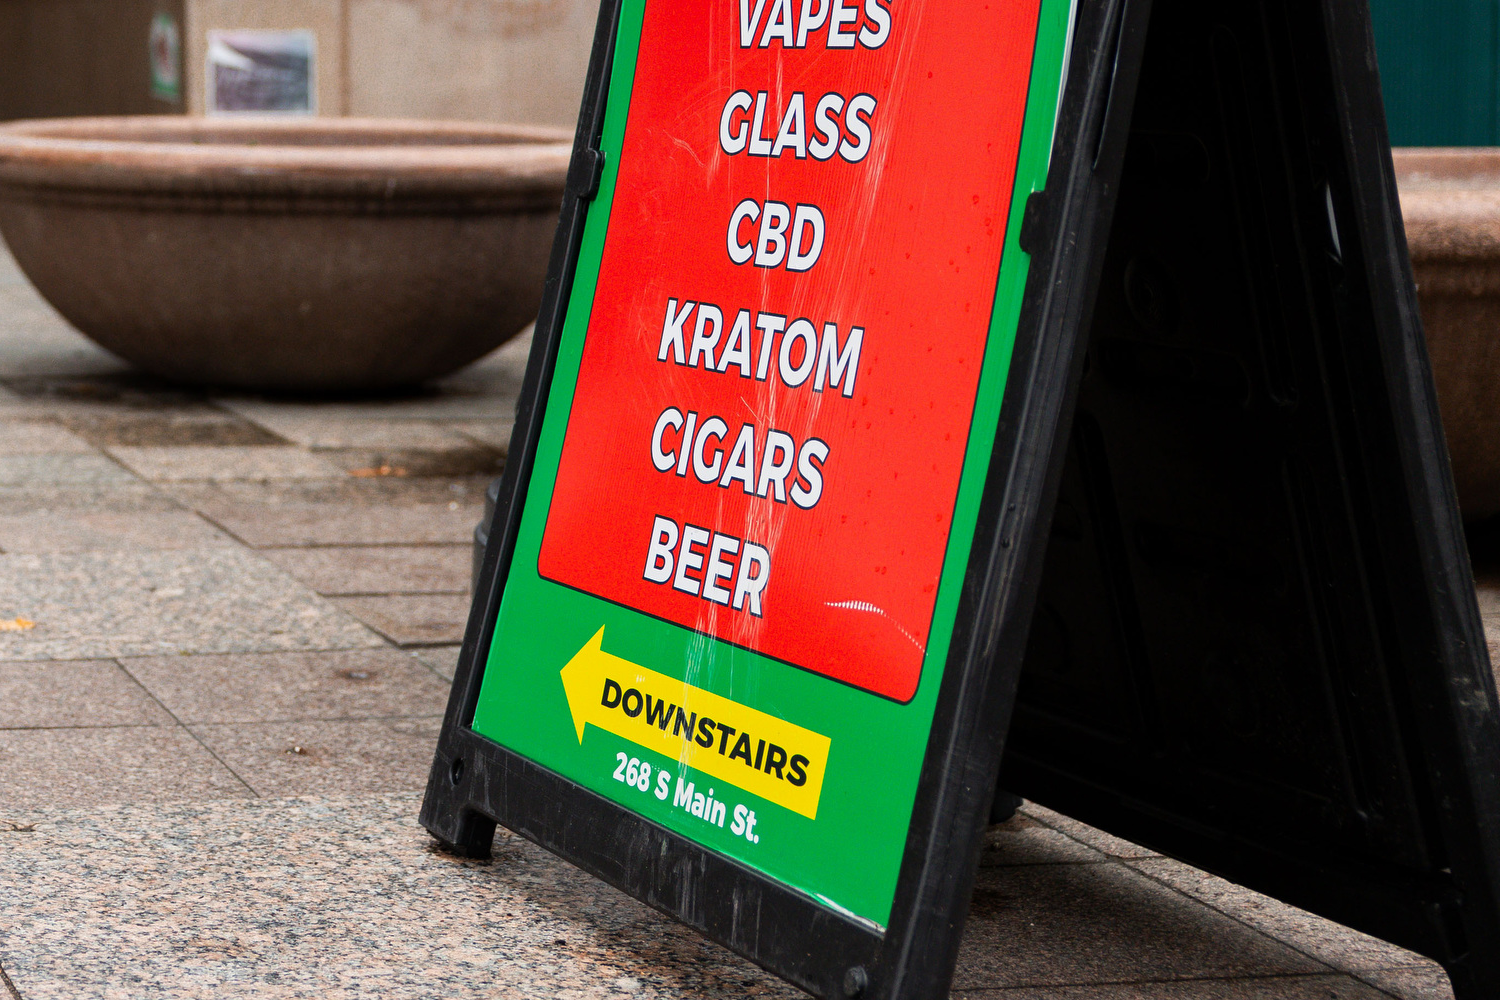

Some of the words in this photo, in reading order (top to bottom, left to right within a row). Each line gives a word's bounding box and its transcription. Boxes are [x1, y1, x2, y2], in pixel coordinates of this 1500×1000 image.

[718, 90, 878, 163] GLASS
[726, 199, 826, 273] CBD
[656, 298, 865, 398] KRATOM
[650, 407, 830, 510] CIGARS
[642, 515, 772, 617] BEER
[600, 677, 811, 788] DOWNSTAIRS
[612, 751, 652, 793] 268
[653, 769, 672, 801] S
[673, 774, 727, 829] Main
[729, 803, 760, 844] St.
